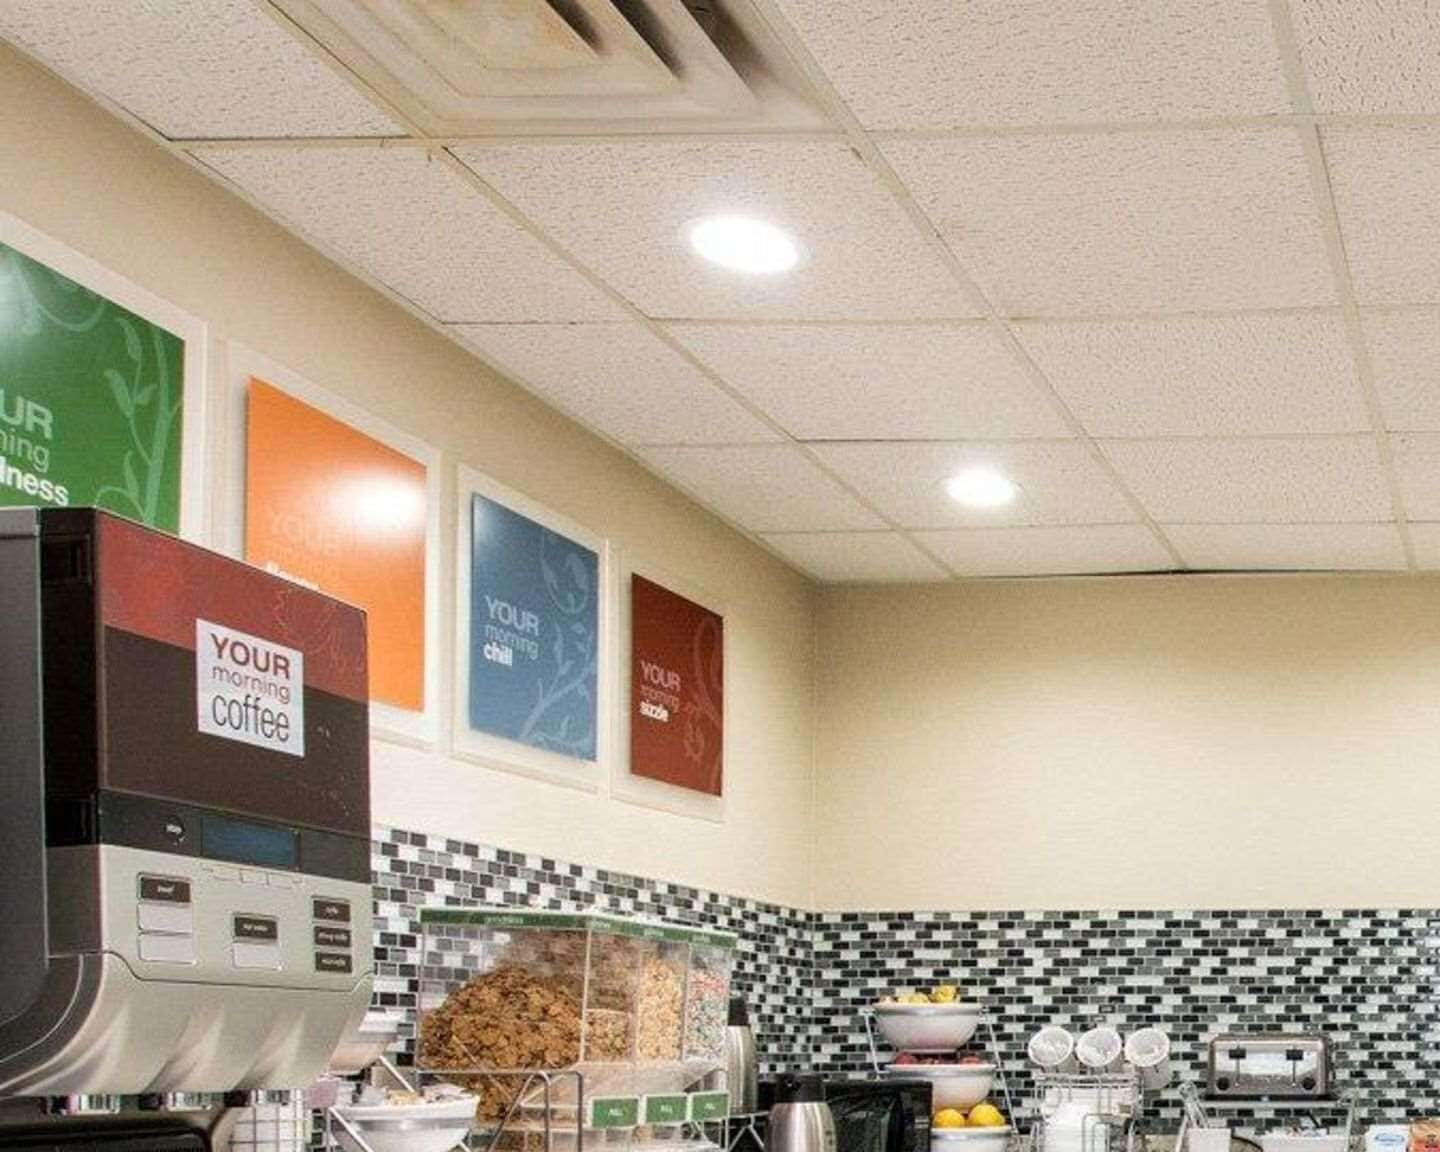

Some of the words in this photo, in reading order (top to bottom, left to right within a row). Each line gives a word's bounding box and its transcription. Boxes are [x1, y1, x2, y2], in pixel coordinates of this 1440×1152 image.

[484, 594, 539, 636] YOUR
[210, 633, 290, 679] YOUR
[641, 659, 681, 692] YOUR
[212, 666, 290, 705] morning
[212, 694, 289, 742] coffee
